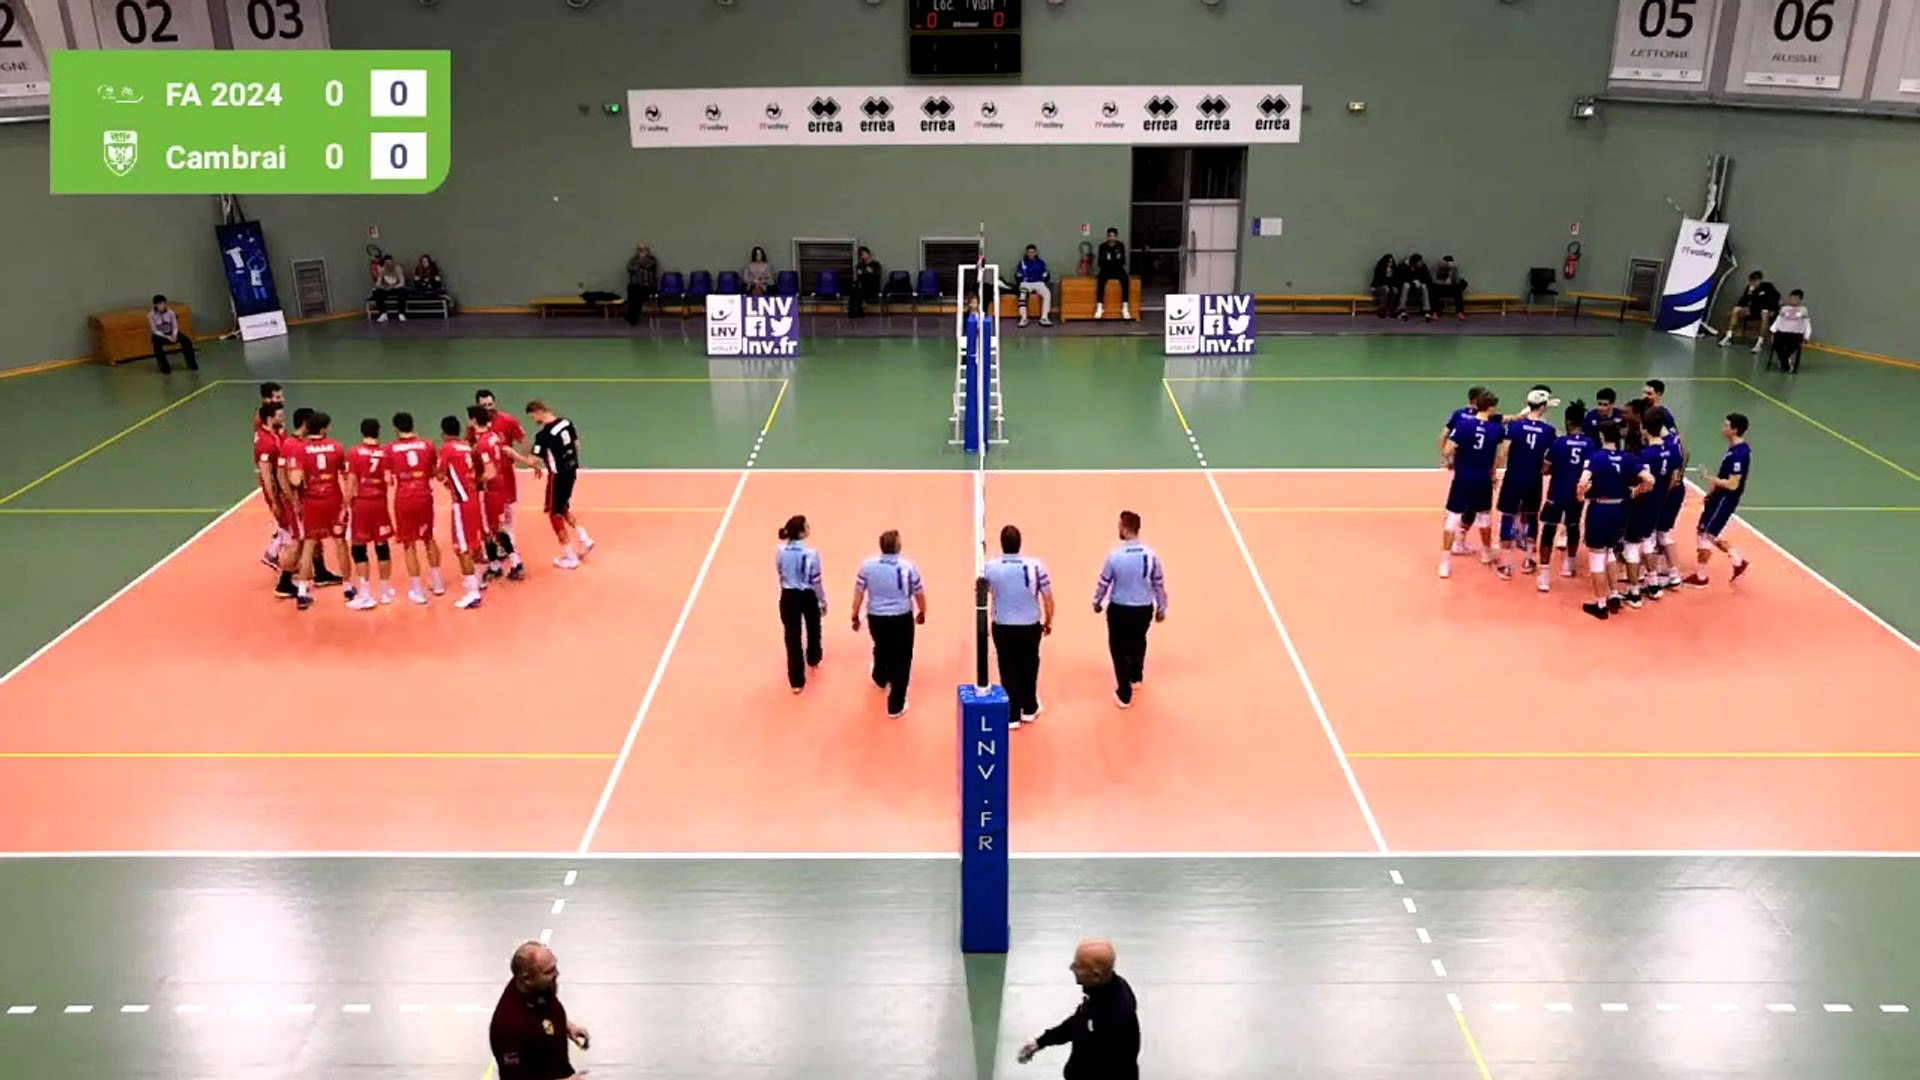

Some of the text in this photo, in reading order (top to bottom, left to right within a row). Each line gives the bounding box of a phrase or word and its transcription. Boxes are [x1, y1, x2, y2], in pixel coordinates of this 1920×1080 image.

[116, 0, 178, 44] 02
[247, 0, 304, 40] 03
[1639, 0, 1697, 38] 05
[1774, 0, 1835, 42] 06
[808, 120, 843, 133] errea
[860, 119, 895, 132] errea
[920, 119, 955, 132] errea
[1143, 118, 1178, 131] errea
[1195, 118, 1230, 131] errea
[1255, 118, 1290, 131] errea
[745, 297, 793, 316] LNV
[1204, 295, 1251, 314] LNV
[711, 326, 738, 337] LNV
[1169, 325, 1195, 336] LNV
[742, 336, 798, 355] lnv.fr
[1200, 334, 1255, 353] lnv.fr
[1473, 433, 1485, 450] 3
[1526, 433, 1537, 450] 4
[1570, 447, 1582, 464] 5
